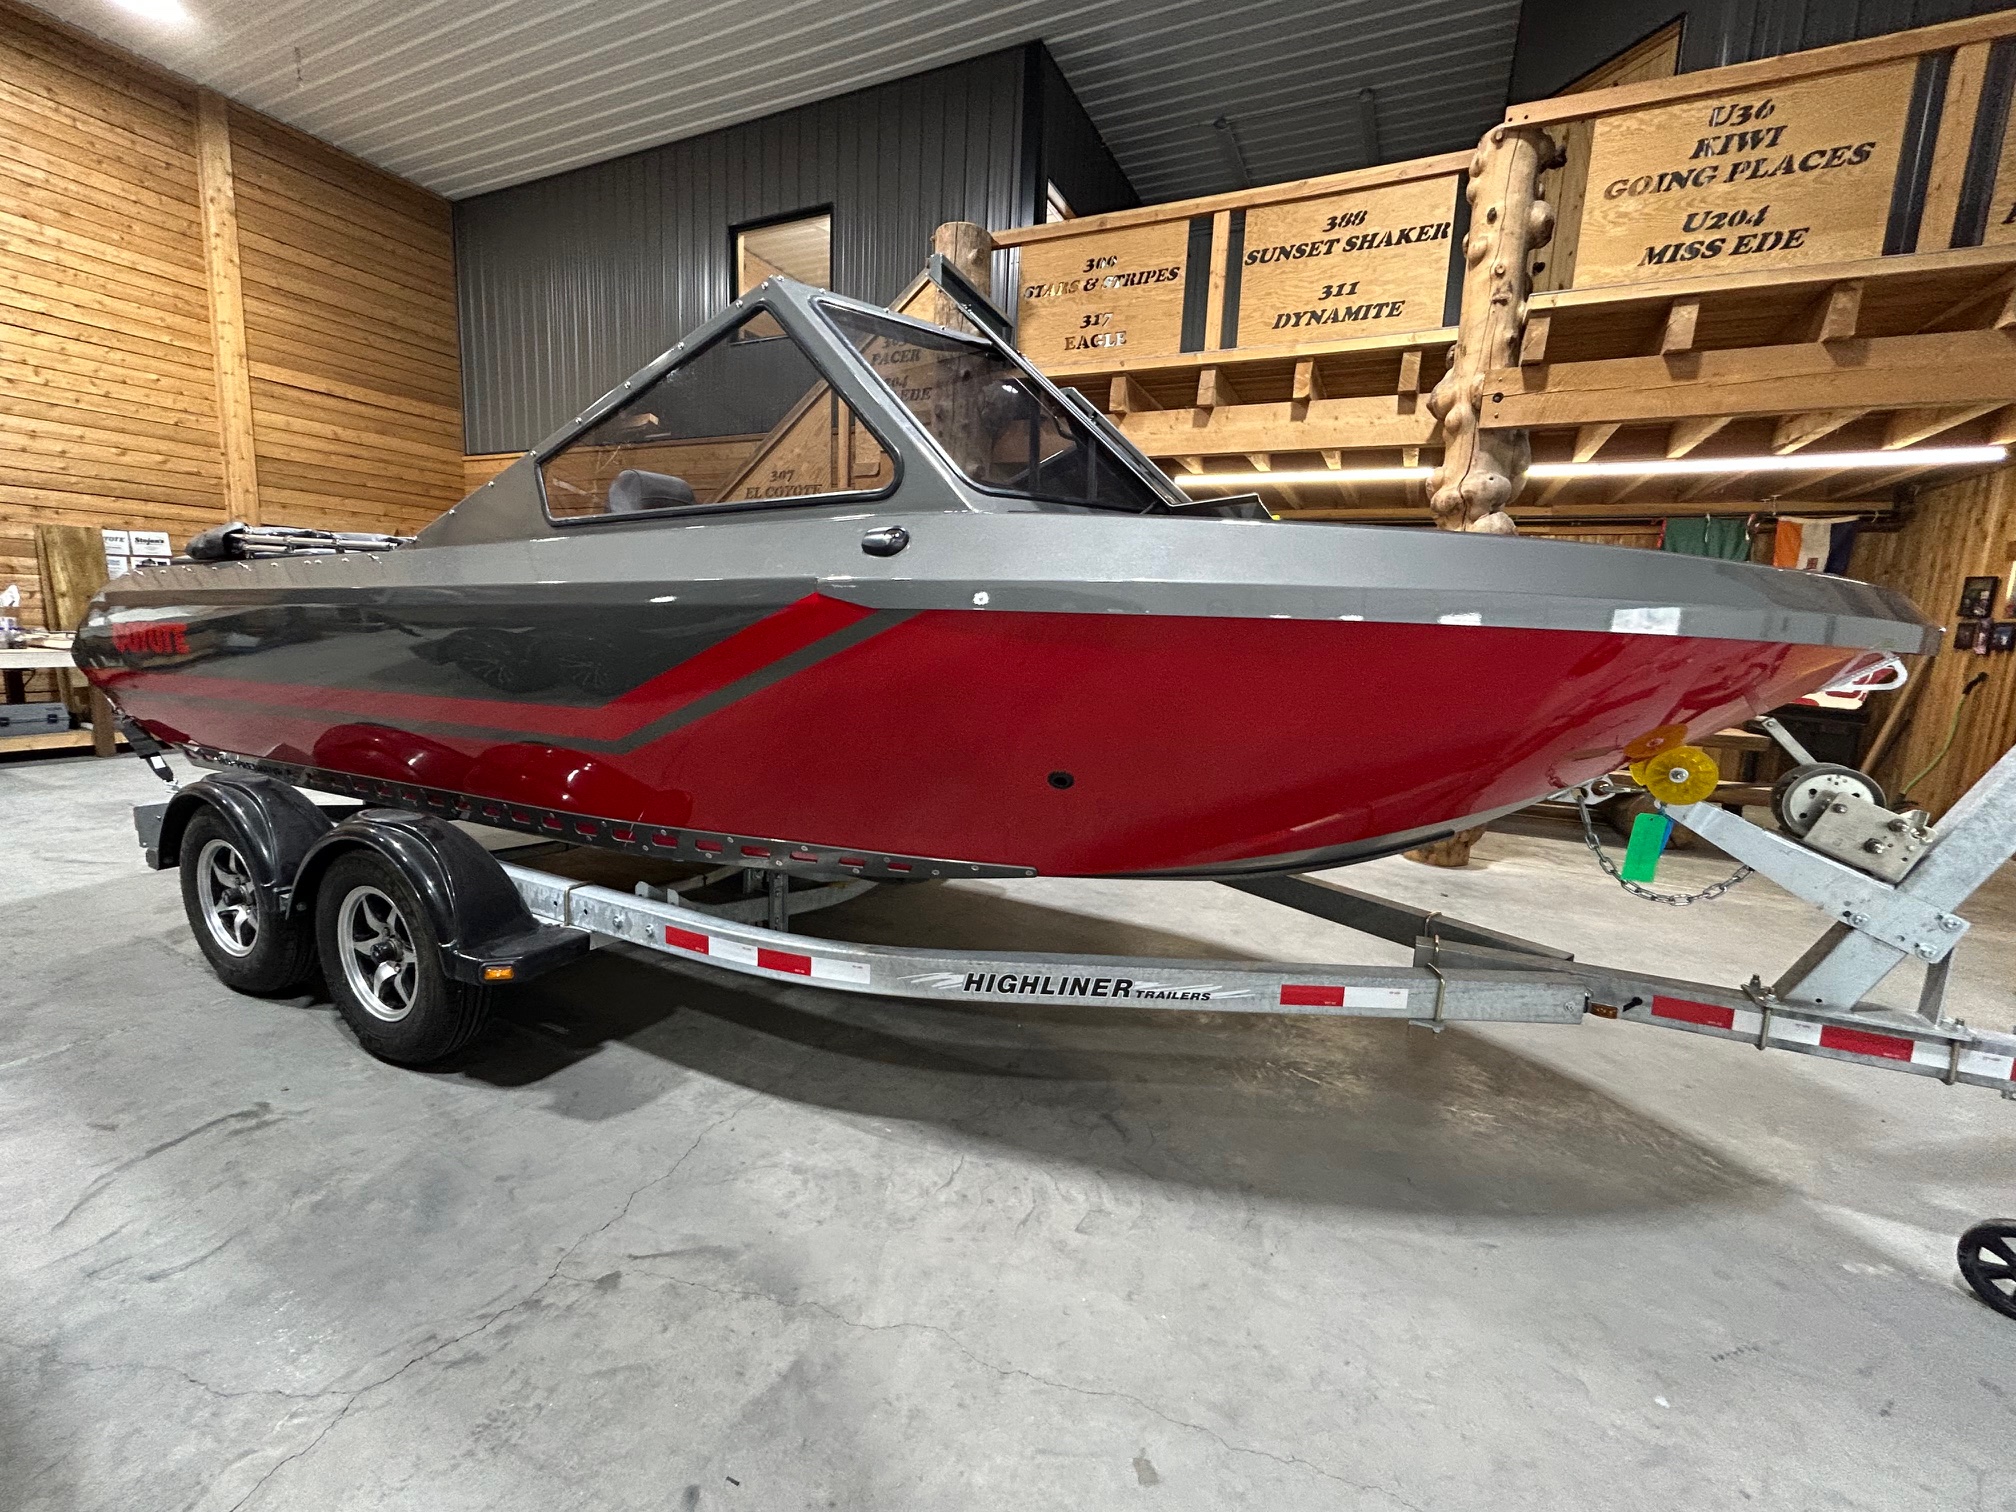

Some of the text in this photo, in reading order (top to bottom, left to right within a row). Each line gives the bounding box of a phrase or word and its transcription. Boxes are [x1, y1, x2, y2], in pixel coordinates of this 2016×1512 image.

[1709, 99, 1776, 127] U36
[1688, 125, 1789, 160] KIWI
[1603, 141, 1877, 200] GOING PLACES
[1322, 210, 1369, 233] 388
[1681, 204, 1771, 233] U204
[1244, 221, 1452, 266] SUNSET SHAKER
[1637, 227, 1810, 267] MISS EDE
[1024, 266, 1181, 299] STARS & STRIPES
[1317, 281, 1361, 301] 311
[1080, 312, 1114, 329] 317
[1271, 300, 1406, 330] DYNAMITE
[1064, 331, 1128, 351] EAGLE
[871, 348, 921, 366] PACER
[769, 468, 796, 483] 307
[744, 486, 763, 500] EL
[963, 972, 1212, 1001] HIGHLINER TRAILERS
